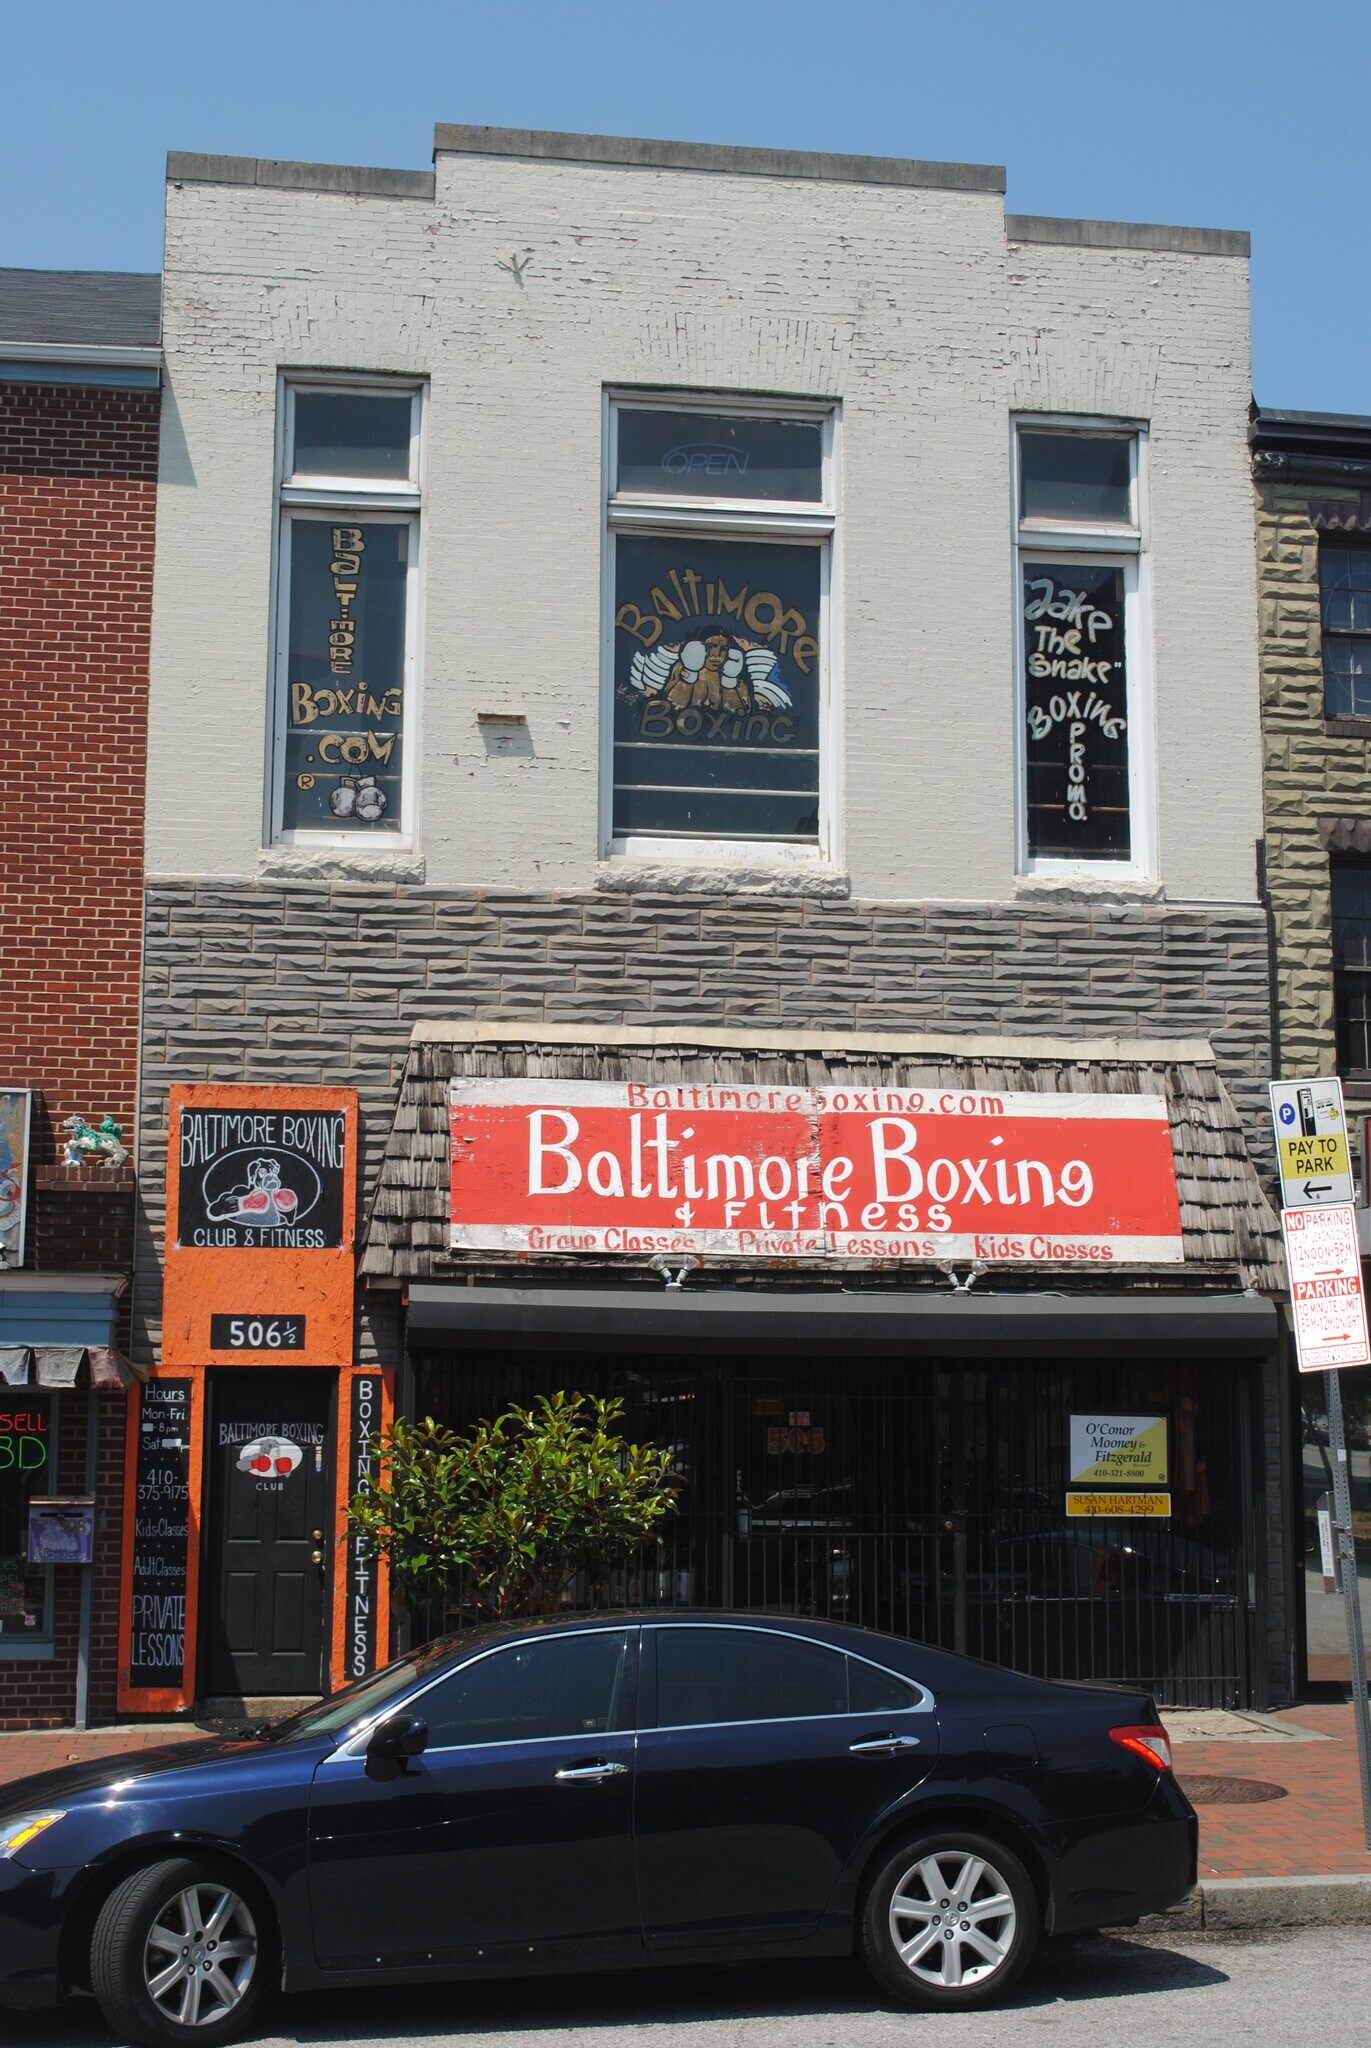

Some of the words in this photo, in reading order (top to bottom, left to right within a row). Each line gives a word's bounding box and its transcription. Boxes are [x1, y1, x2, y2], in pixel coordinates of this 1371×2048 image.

[664, 453, 748, 475] OPEN
[1034, 625, 1082, 655] The
[180, 1114, 277, 1167] BALTIMORE
[282, 1116, 345, 1169] BOXING
[1288, 1140, 1313, 1156] PAY
[1318, 1138, 1337, 1153] TO
[525, 1108, 853, 1202] Baltimore
[865, 1117, 1094, 1207] Boxing
[1296, 1157, 1334, 1174] PARK
[724, 1201, 952, 1231] Fitness
[1286, 1213, 1303, 1230] NO
[1305, 1210, 1350, 1228] PARKING
[193, 1227, 237, 1247] CLUB
[260, 1228, 325, 1248] FITNESS
[604, 1227, 697, 1251] Classes
[738, 1230, 817, 1254] Private
[829, 1232, 937, 1256] Lessons
[974, 1235, 1025, 1258] Kids
[1030, 1236, 1114, 1260] Classes
[1296, 1278, 1357, 1299] PARKING
[145, 1384, 186, 1400] Hours
[218, 1422, 279, 1446] BALTIMORE
[281, 1423, 324, 1445] BOXING
[357, 1380, 373, 1496] BOXING
[1085, 1422, 1135, 1436] O'Conor
[767, 1426, 826, 1455] 506
[1090, 1437, 1138, 1452] Mooney
[1138, 1441, 1146, 1449] &
[1095, 1450, 1152, 1466] Fitzgerald
[1093, 1469, 1145, 1478] 410-321-8800
[137, 1484, 189, 1500] 375-9175
[255, 1482, 284, 1491] CLUB
[1073, 1495, 1107, 1505] SUSAN
[1109, 1495, 1163, 1505] HARTMAN
[132, 1595, 186, 1630] PRIVATE
[353, 1536, 370, 1677] FITNESS
[131, 1632, 185, 1667] LESSONS
